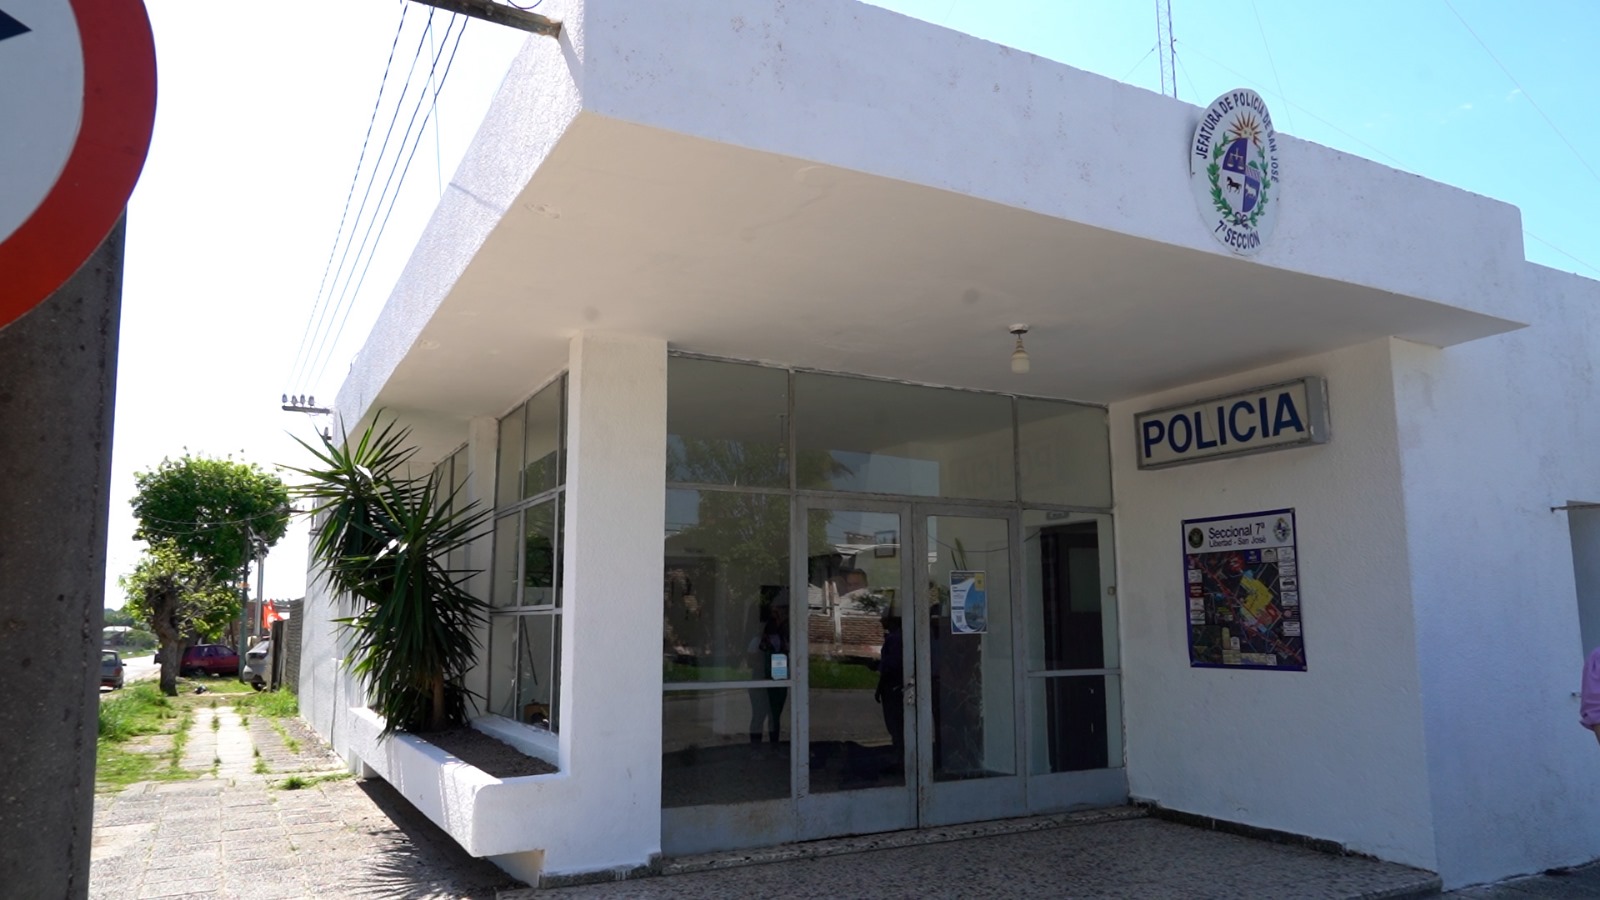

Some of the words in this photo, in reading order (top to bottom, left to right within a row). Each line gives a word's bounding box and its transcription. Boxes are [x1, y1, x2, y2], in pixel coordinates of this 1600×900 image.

[1195, 108, 1223, 160] JEFATURA
[1219, 96, 1235, 112] DE
[1233, 92, 1264, 114] POLICIA
[1262, 112, 1272, 130] DE
[1267, 130, 1278, 153] SAN
[1142, 392, 1305, 458] POLICIA
[1208, 523, 1253, 540] Seccional
[1208, 538, 1233, 548] Libertad
[1237, 537, 1250, 546] San
